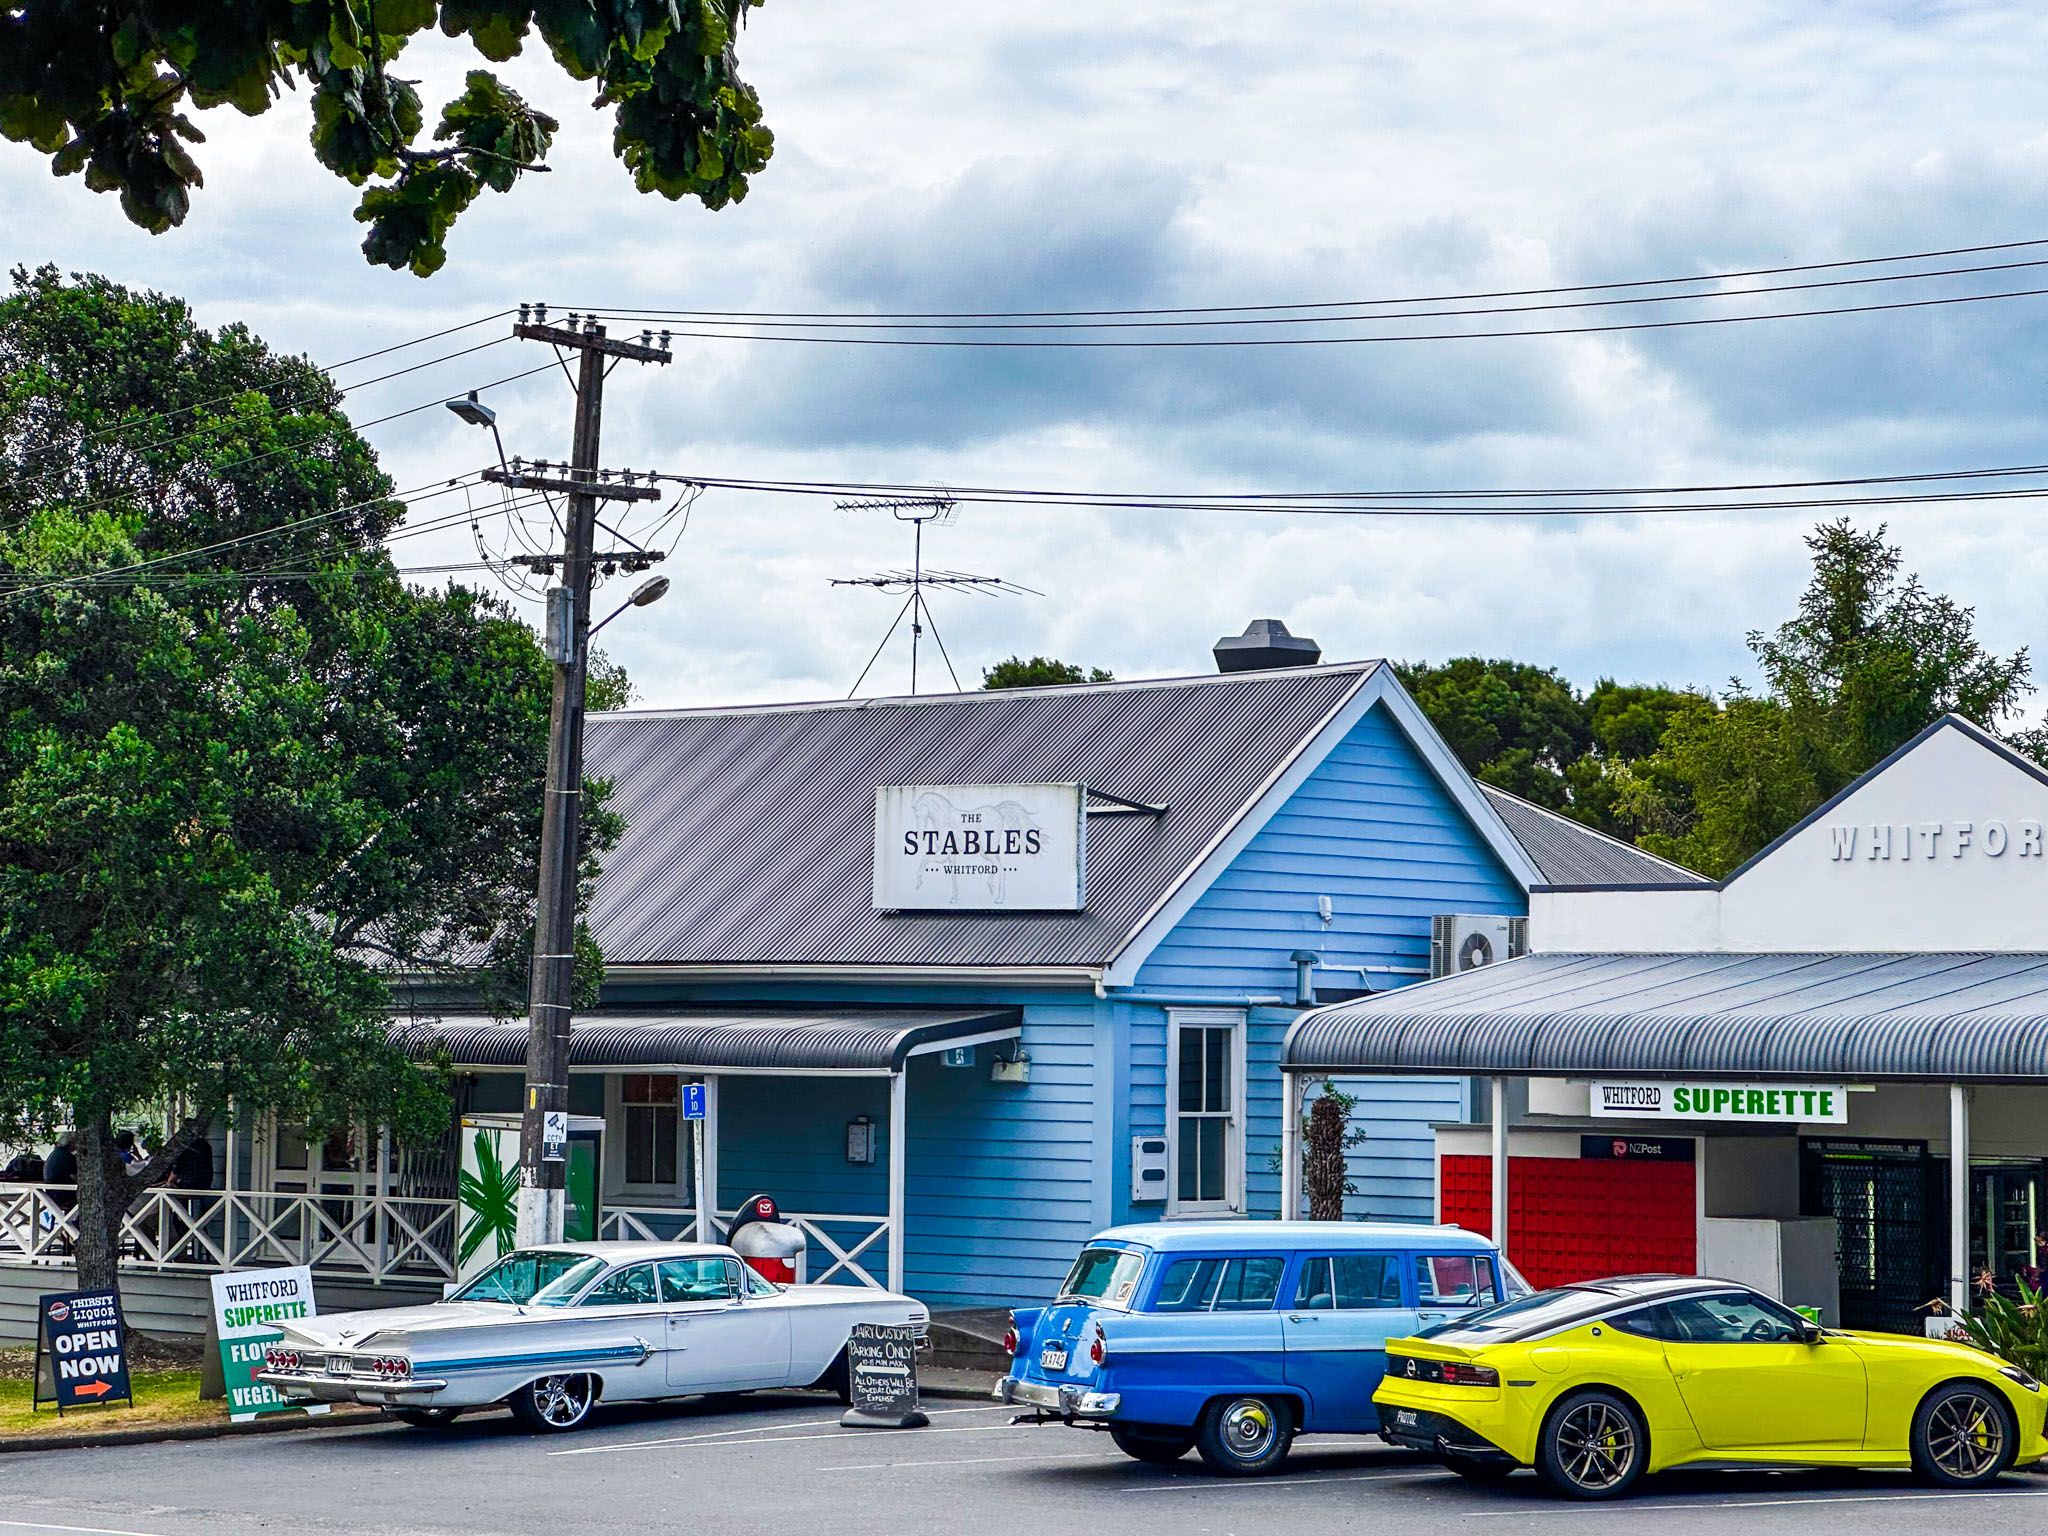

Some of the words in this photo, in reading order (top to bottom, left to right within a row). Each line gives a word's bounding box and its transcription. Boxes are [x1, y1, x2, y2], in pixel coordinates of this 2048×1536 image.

[961, 813, 982, 823] THE
[904, 829, 1041, 855] STABLES
[943, 865, 998, 874] WHITFORD
[690, 1087, 698, 1100] P
[691, 1101, 698, 1111] 10
[1602, 1086, 1661, 1105] WHITFORD
[1673, 1087, 1833, 1116] SUPERETTE
[547, 1134, 562, 1142] CCTV
[1629, 1143, 1662, 1154] NZPost
[226, 1279, 298, 1303] WHITFORD
[70, 1296, 114, 1309] THIRSTY
[73, 1306, 116, 1320] LIQUOR
[224, 1301, 307, 1328] SUPERETTE
[77, 1319, 117, 1328] WHITFORD
[55, 1330, 118, 1354] OPEN
[849, 1340, 883, 1358] PARKING
[885, 1342, 912, 1359] ONLY
[59, 1354, 120, 1379] NOW
[855, 1375, 866, 1385] ALL
[905, 1377, 915, 1388] BE
